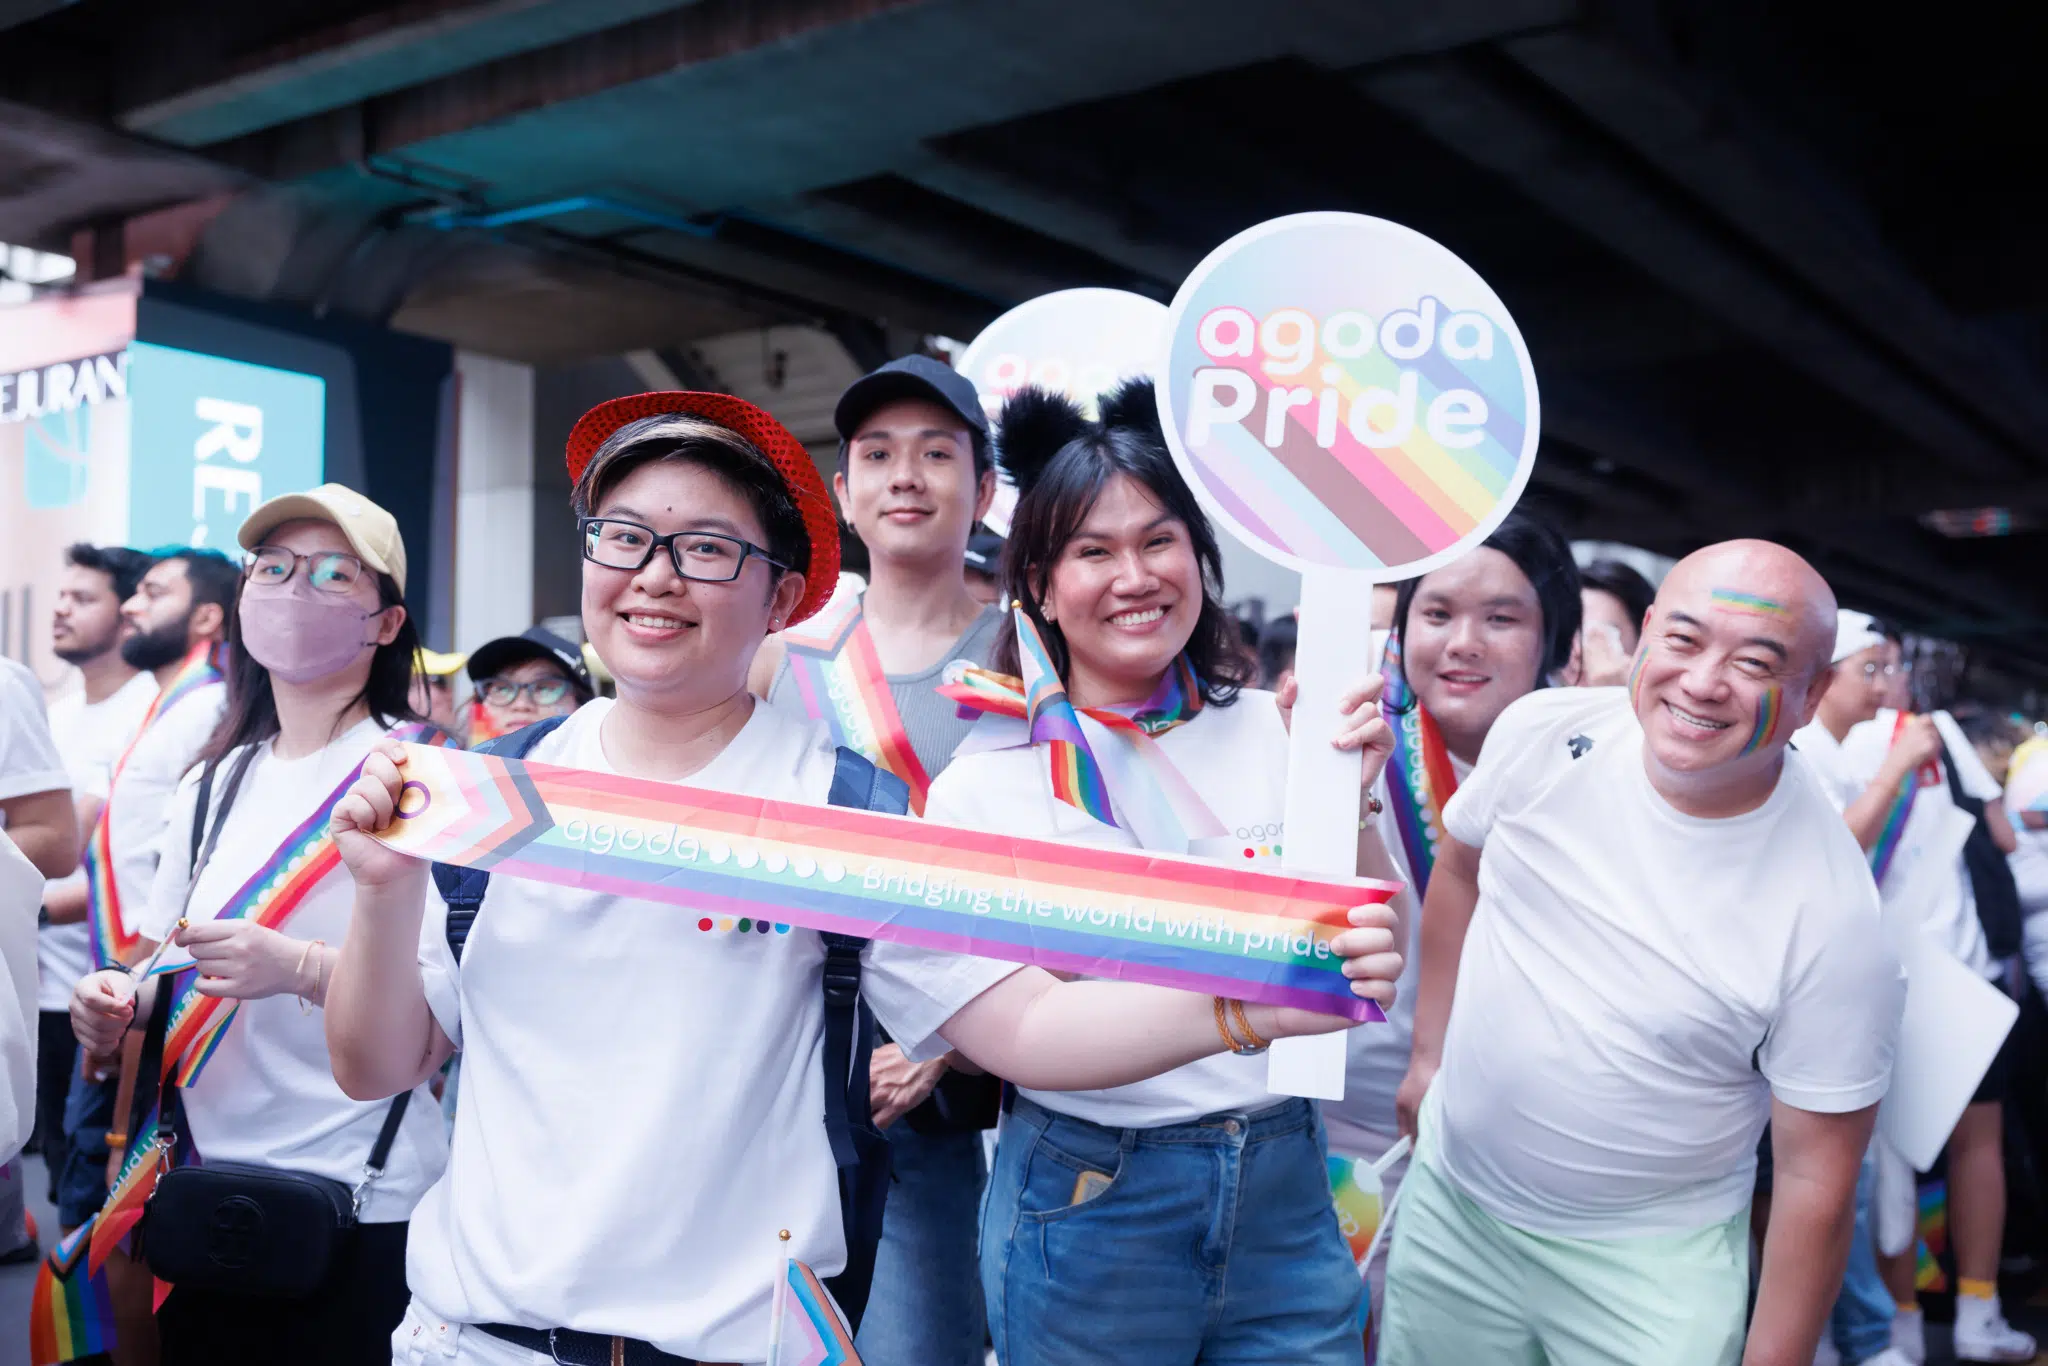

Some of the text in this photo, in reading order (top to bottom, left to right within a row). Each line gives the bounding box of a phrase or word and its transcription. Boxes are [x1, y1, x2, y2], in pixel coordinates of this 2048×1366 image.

[1197, 295, 1495, 376] agoda
[1185, 363, 1489, 450] Pride
[191, 396, 264, 549] RE
[1401, 703, 1426, 787] goda
[563, 819, 1331, 961] agoda Bridging the world with pride
